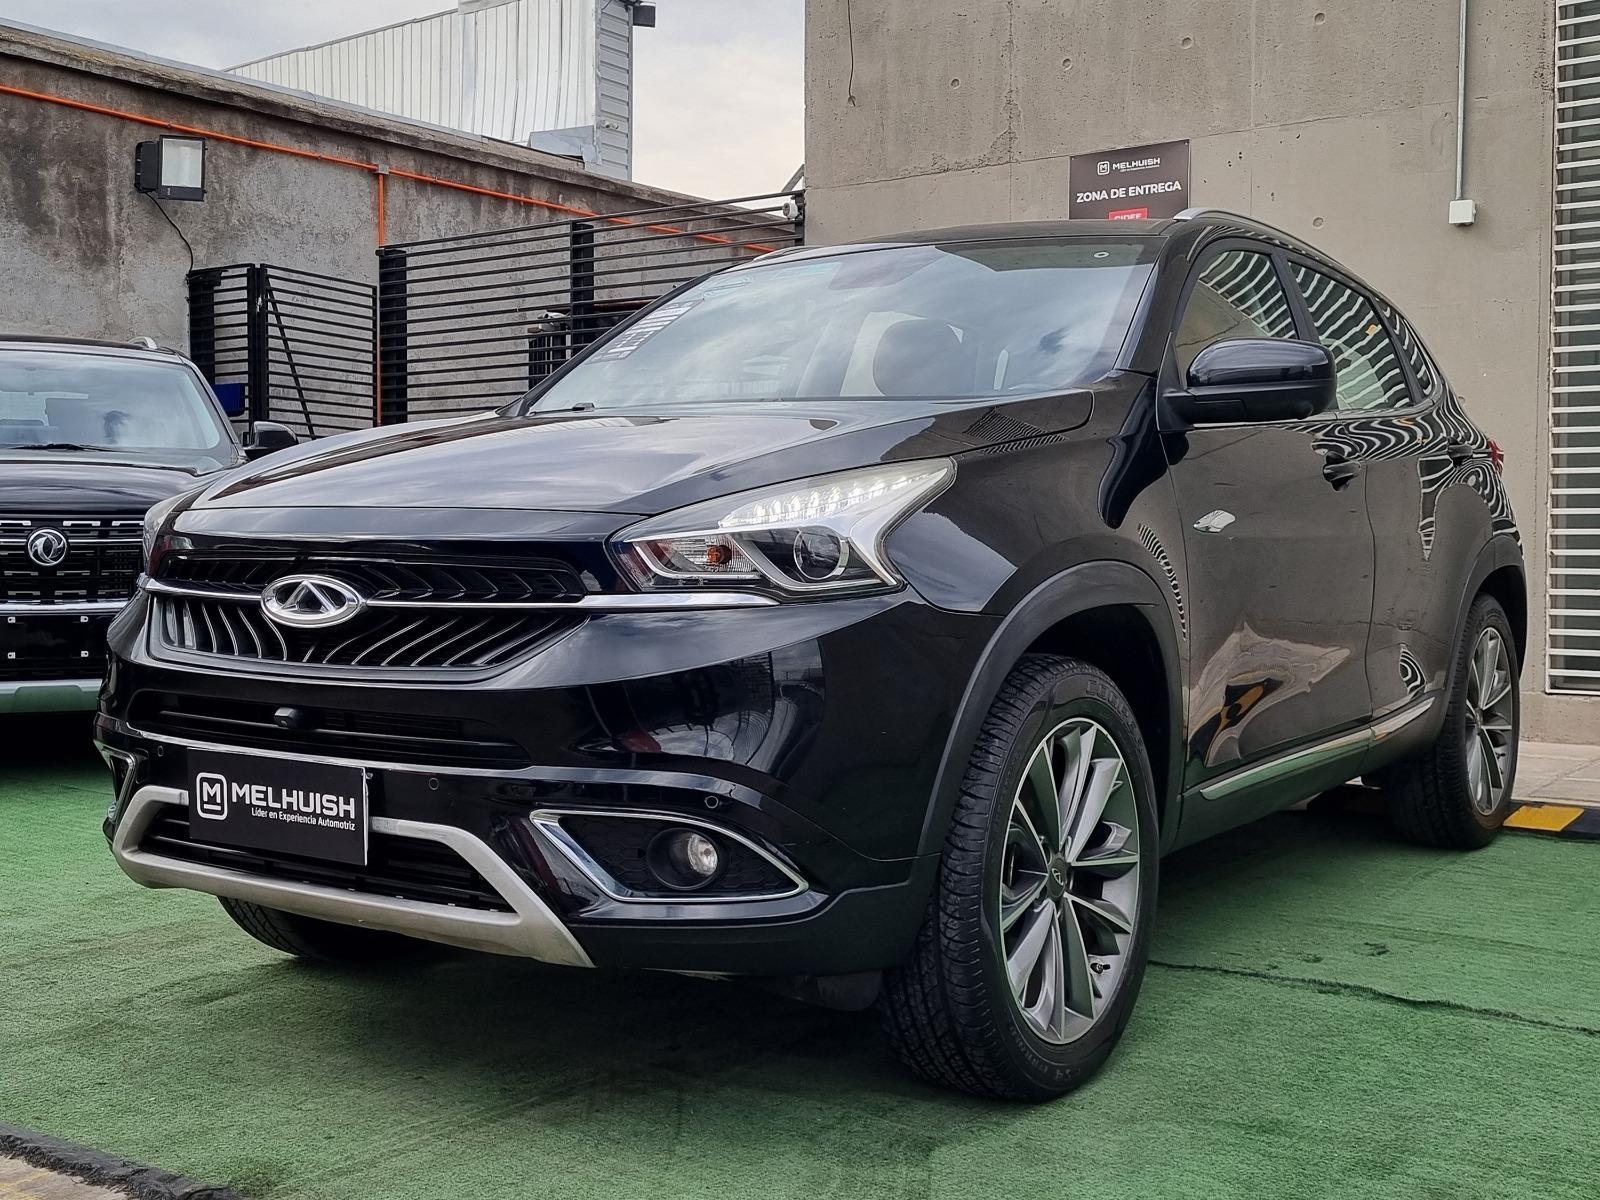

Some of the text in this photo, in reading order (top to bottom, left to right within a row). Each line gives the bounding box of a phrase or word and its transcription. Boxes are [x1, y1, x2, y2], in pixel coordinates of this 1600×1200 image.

[1112, 157, 1161, 170] MELHUISH
[1076, 180, 1182, 203] ZONA DE ENTREGA
[231, 782, 355, 819] MELHUISH
[268, 811, 278, 819] en
[278, 811, 317, 825] Experiencia
[317, 816, 356, 831] Automotriz
